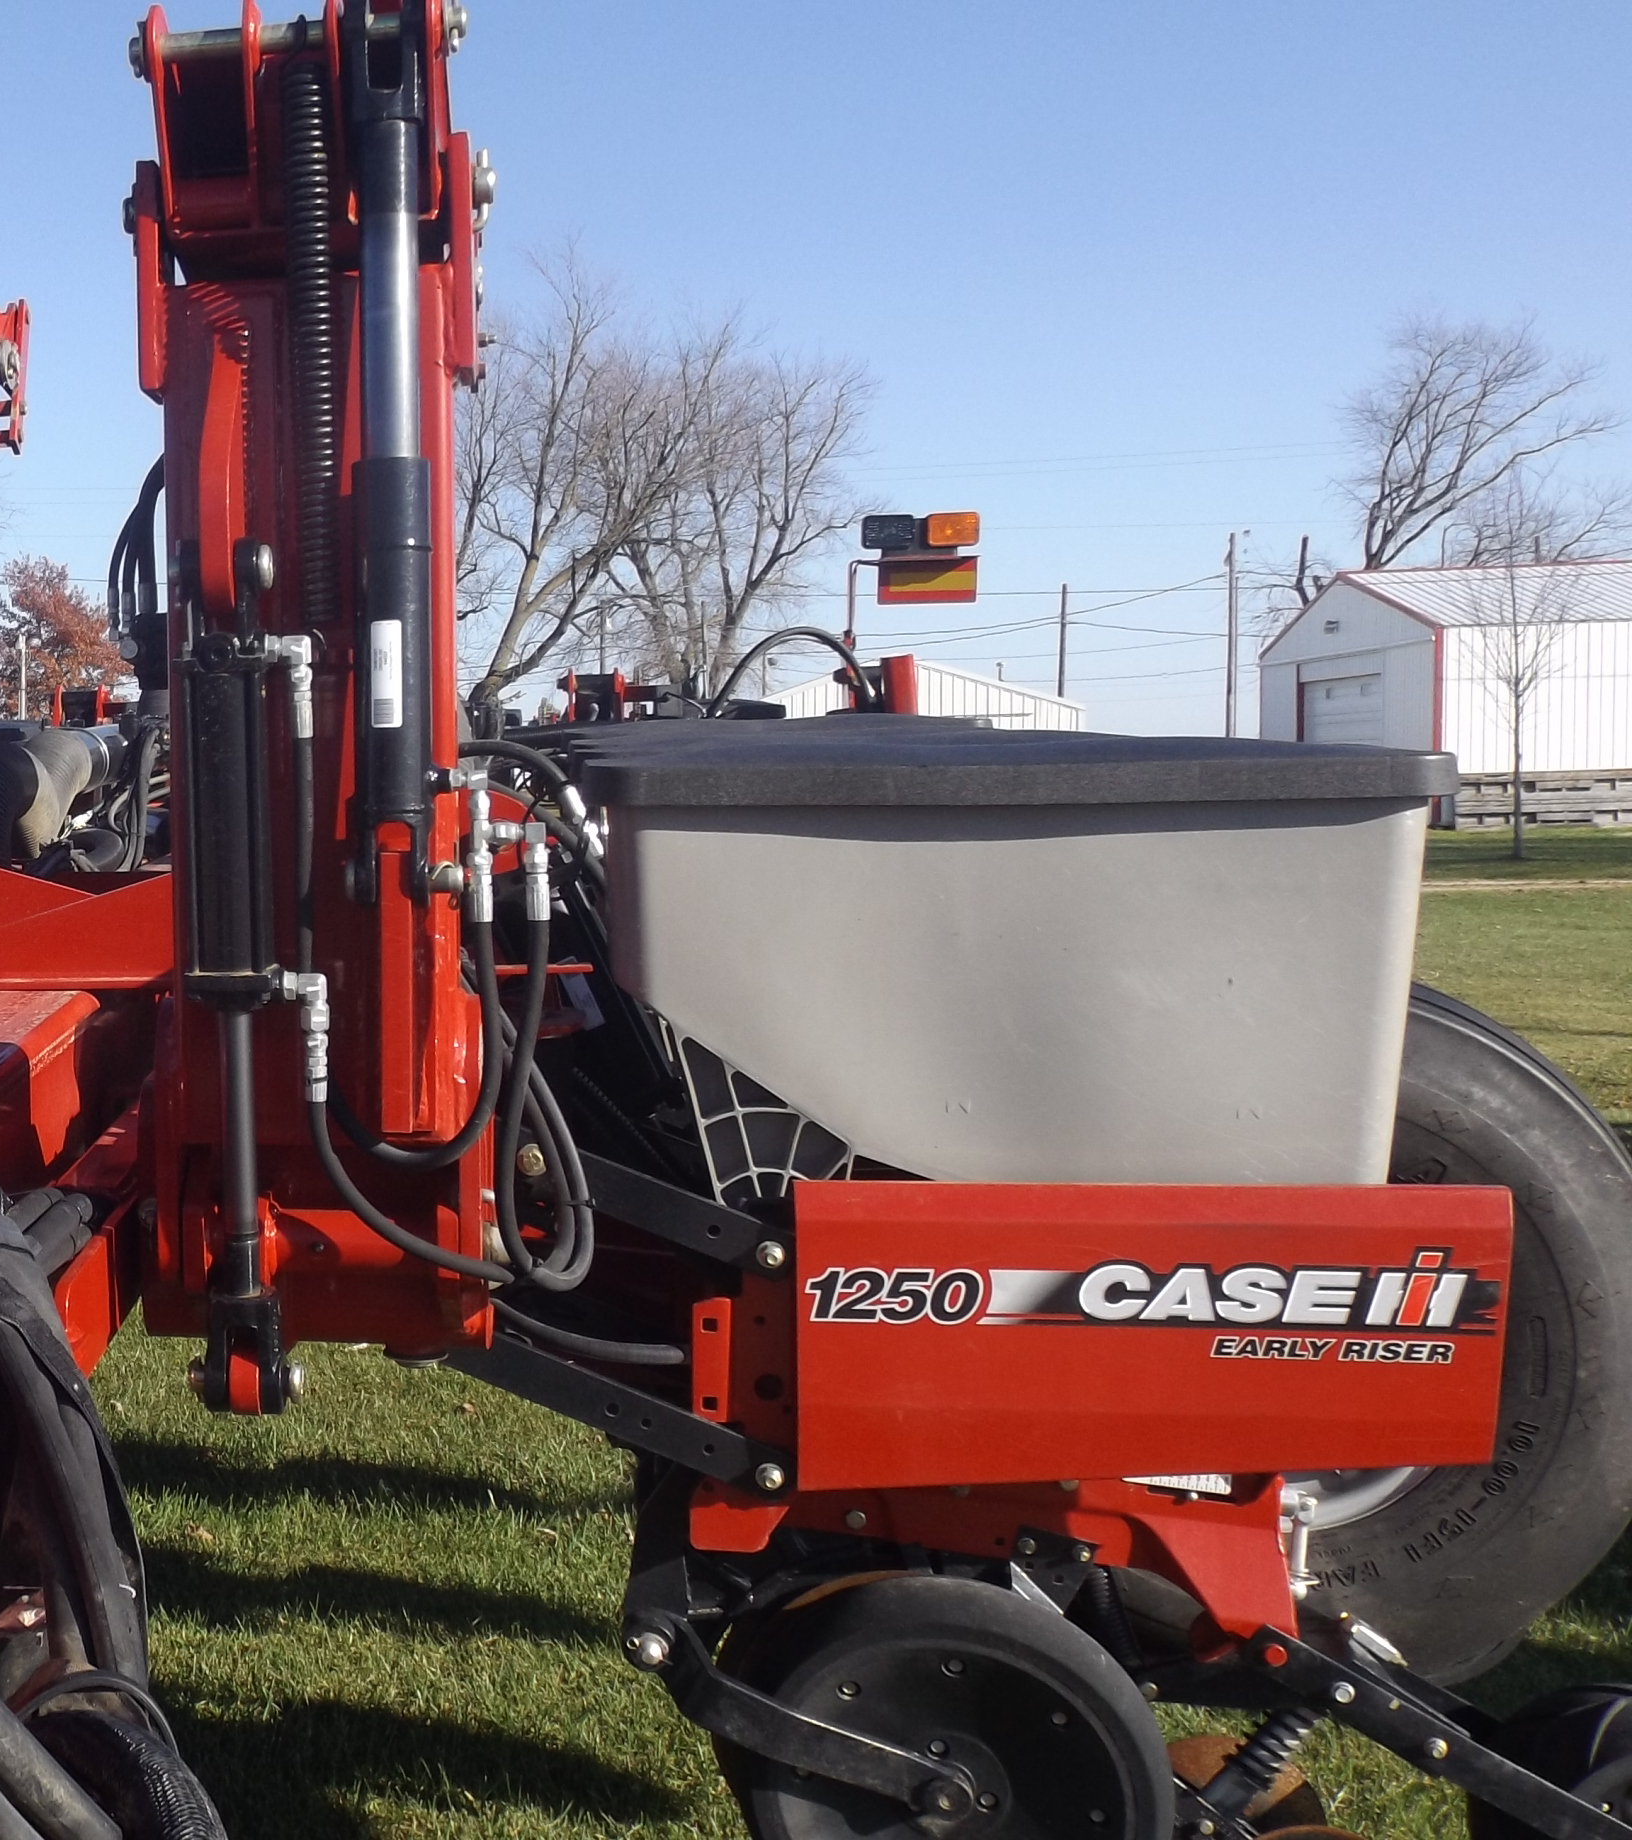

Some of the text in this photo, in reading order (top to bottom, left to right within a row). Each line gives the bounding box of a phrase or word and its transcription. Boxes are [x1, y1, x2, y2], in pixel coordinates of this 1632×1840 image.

[805, 1267, 984, 1325] 1250
[1078, 1264, 1362, 1324] CASE
[1210, 1336, 1455, 1364] EARLY RISER
